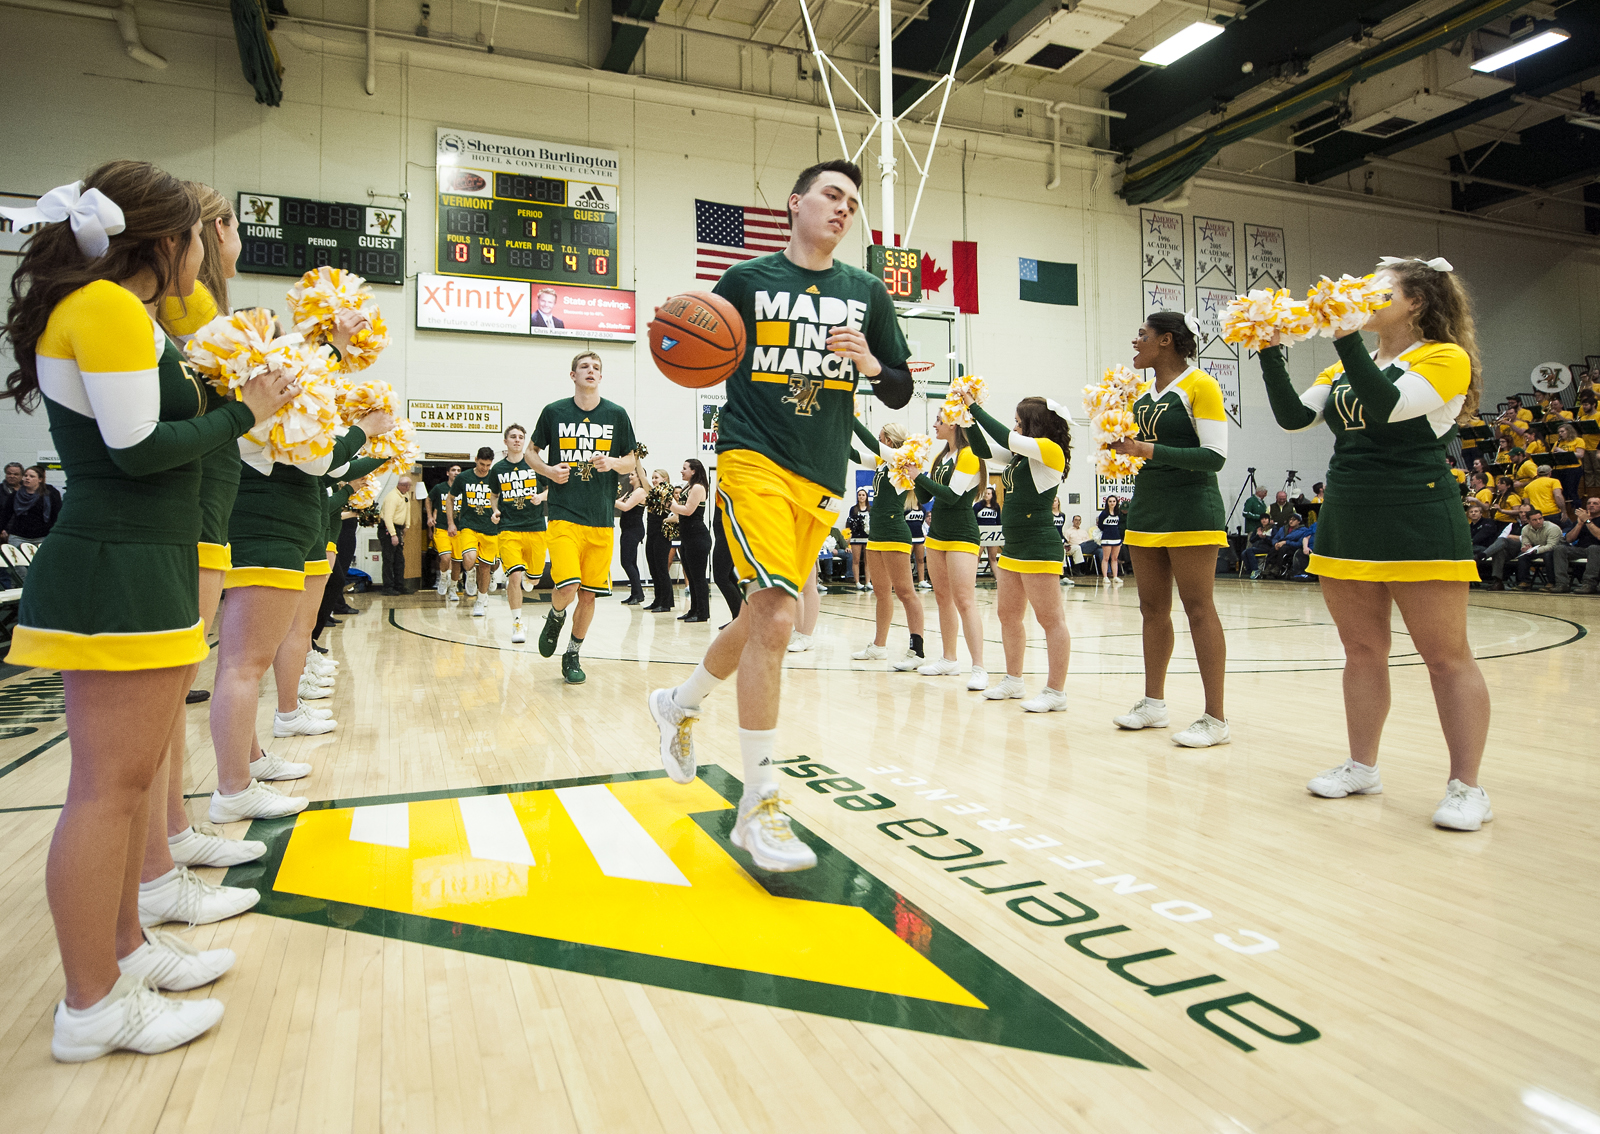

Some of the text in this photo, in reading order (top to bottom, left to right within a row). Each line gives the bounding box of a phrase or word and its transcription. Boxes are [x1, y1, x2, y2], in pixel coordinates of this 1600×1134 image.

[467, 139, 535, 158] Sheraton
[539, 148, 617, 169] Burlington
[472, 154, 502, 164] HOTEL
[516, 160, 575, 173] CONFERENCE
[578, 169, 613, 178] CENTER
[442, 195, 494, 211] VERMONT
[575, 199, 610, 211] adidas
[518, 209, 543, 218] PERIOD
[574, 210, 606, 221] GUEST
[247, 225, 283, 239] HOME
[307, 237, 338, 247] PERIOD
[358, 236, 396, 249] GUEST
[447, 234, 471, 243] FOULS
[479, 237, 499, 246] T.O.L.
[505, 240, 555, 251] PLAYER FOUL
[561, 245, 580, 254] T.O.L.
[1147, 242, 1180, 251] ACADEMIC
[455, 243, 468, 262] 0
[482, 247, 495, 264] 4
[588, 249, 609, 257] FOULS
[1200, 249, 1232, 258] ACADEMIC
[565, 255, 577, 271] 4
[885, 250, 918, 269] 5:38
[1251, 255, 1283, 264] ACADEMIC
[595, 257, 607, 275] 0
[423, 281, 525, 317] xfinity
[563, 296, 586, 305] State
[587, 298, 596, 306] of
[755, 290, 867, 331] MADE
[428, 317, 441, 325] the
[443, 317, 468, 327] future
[480, 322, 517, 330] awesome
[795, 322, 827, 350] IN
[752, 346, 854, 381] MARCH
[421, 411, 490, 422] CHAMPIONS
[559, 423, 614, 439] MADE
[579, 438, 593, 450] IN
[498, 469, 536, 483] MADE
[1121, 475, 1135, 484] SEA
[513, 480, 523, 489] IN
[502, 486, 537, 498] MARCH
[467, 498, 491, 506] MARC
[866, 764, 1280, 955] CONFERENCE
[877, 818, 1321, 1053] america
